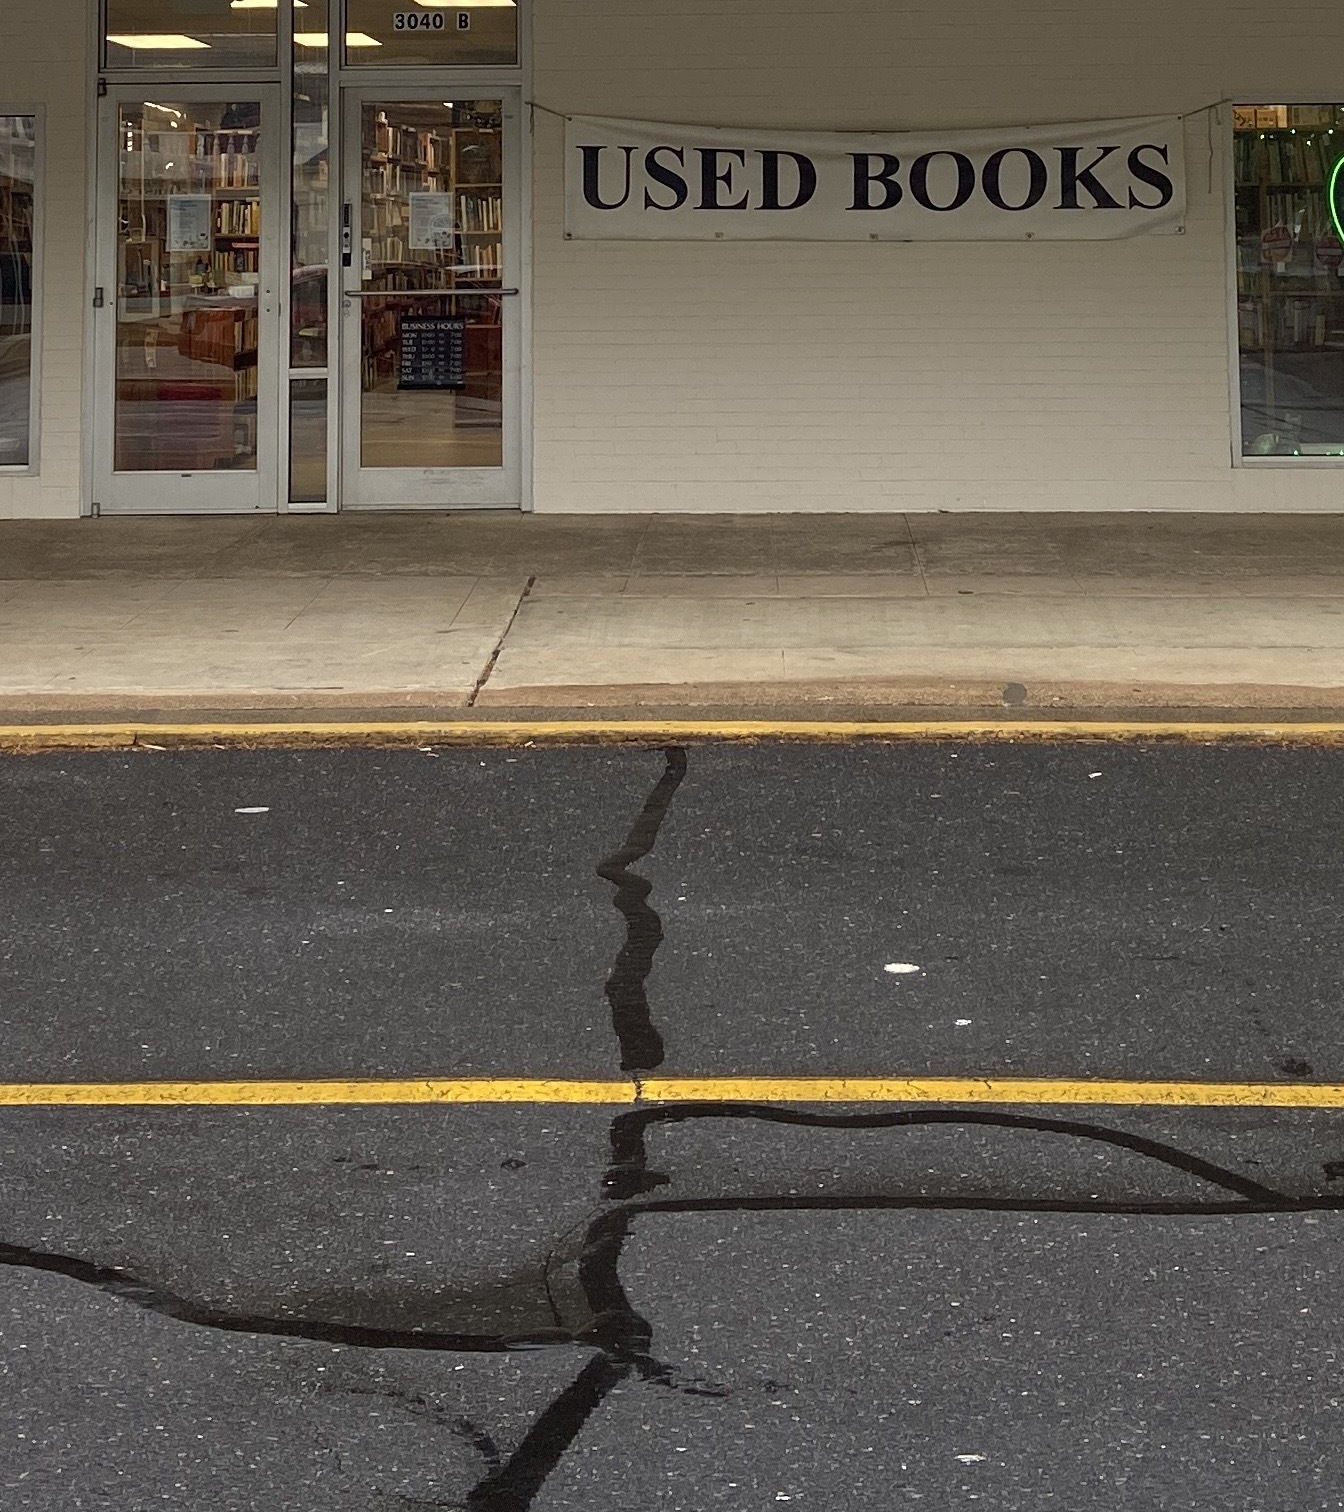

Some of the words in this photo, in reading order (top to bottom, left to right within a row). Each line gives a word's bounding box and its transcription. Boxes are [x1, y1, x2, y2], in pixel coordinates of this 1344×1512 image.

[394, 13, 443, 29] 3040
[458, 13, 469, 29] B
[575, 145, 818, 212] USED
[844, 143, 1174, 212] BOOKS
